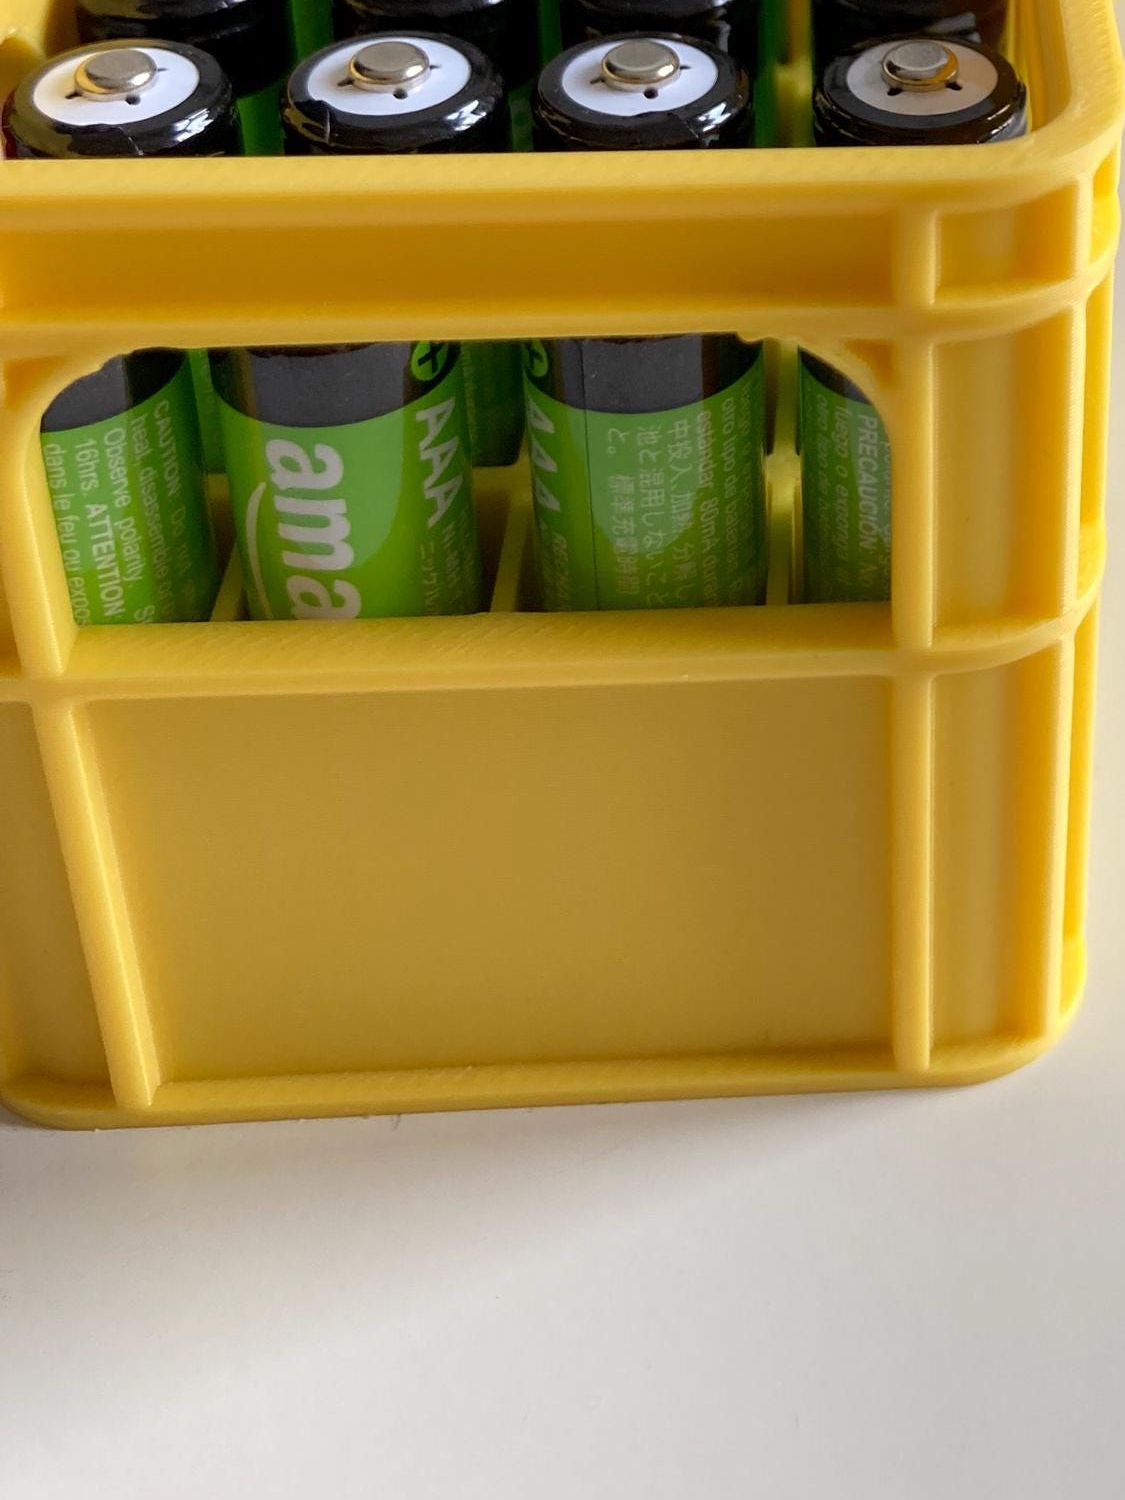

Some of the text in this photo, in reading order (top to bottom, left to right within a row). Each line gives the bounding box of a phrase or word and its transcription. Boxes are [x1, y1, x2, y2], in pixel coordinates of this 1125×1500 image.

[530, 395, 561, 513] AAA
[833, 405, 851, 459] fuego
[44, 443, 67, 489] dans
[74, 439, 101, 497] 16hrs.
[103, 427, 131, 508] Observe
[415, 396, 464, 530] AAA
[53, 494, 75, 510] le
[57, 515, 80, 544] feu
[64, 549, 82, 571] ou
